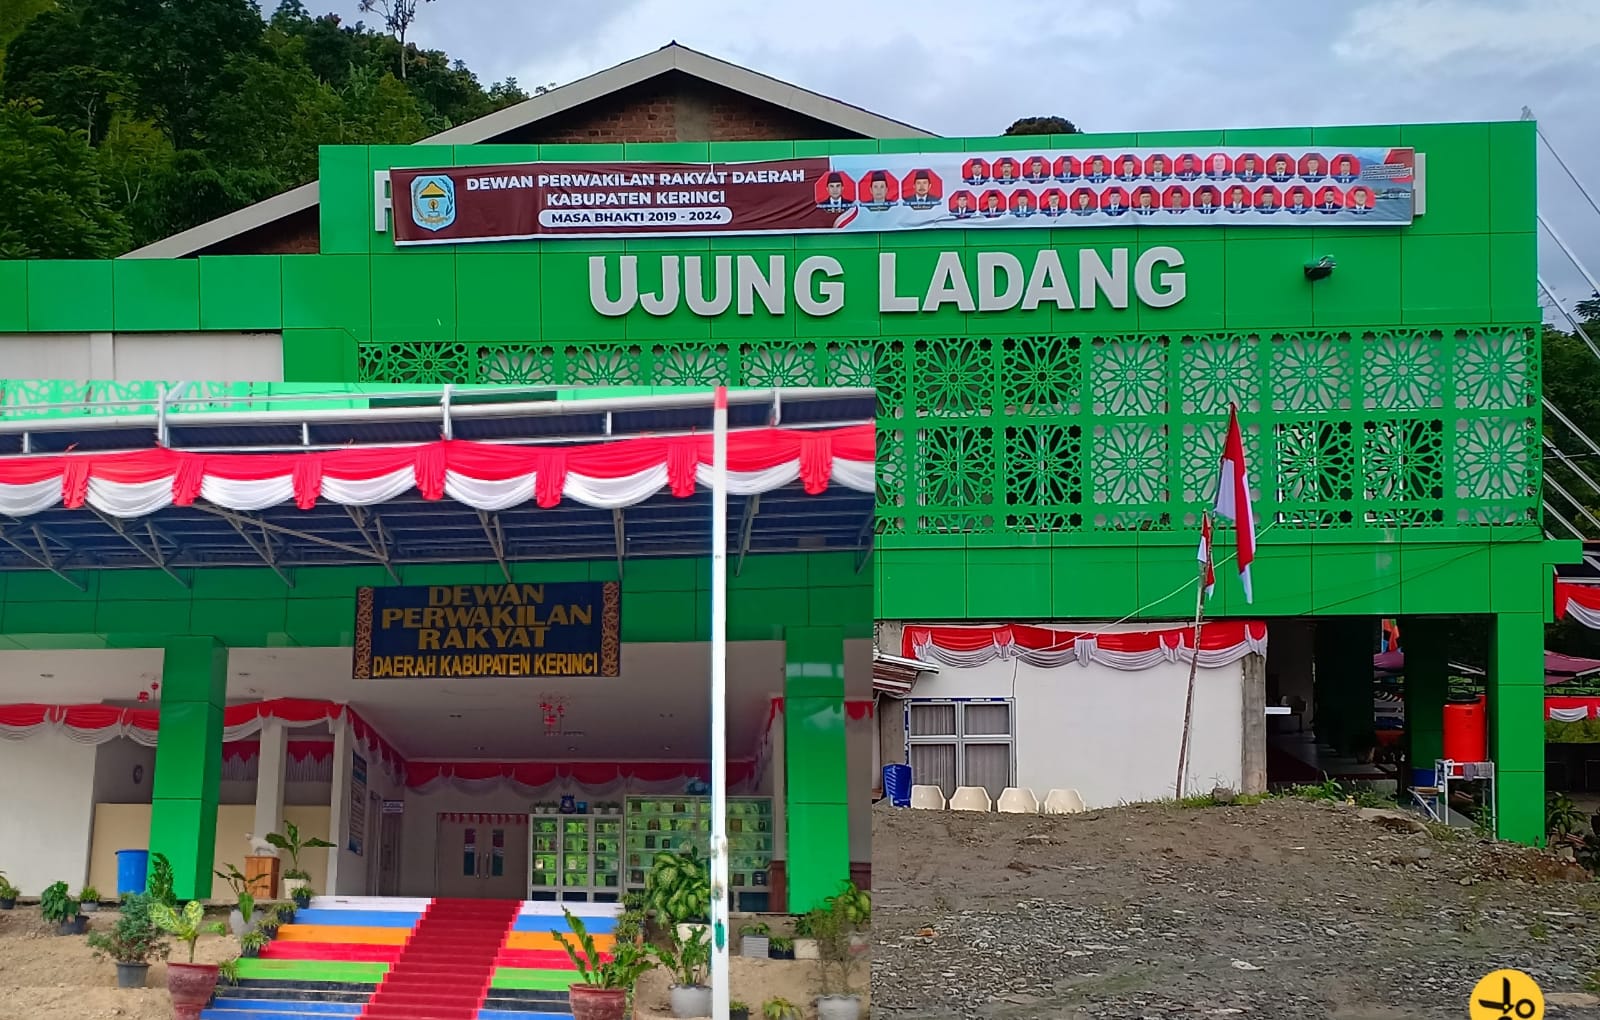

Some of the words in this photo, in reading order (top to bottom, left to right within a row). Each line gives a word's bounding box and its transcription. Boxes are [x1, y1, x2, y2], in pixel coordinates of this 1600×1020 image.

[466, 175, 533, 191] DEWAN
[538, 172, 655, 187] PERWAKILAN
[659, 171, 728, 186] RAKYAT
[731, 169, 805, 184] DAERAH
[547, 191, 652, 207] KABUPATEN
[656, 190, 725, 204] KERINCI
[551, 212, 591, 224] MASA
[594, 212, 645, 223] BHAKTI
[648, 211, 677, 222] 2019
[688, 210, 722, 221] 2024
[588, 255, 845, 317] UJUNG
[878, 246, 1187, 313] LADANG
[429, 584, 545, 606] DEWAN
[381, 604, 592, 629] PERWAKILAN
[417, 627, 550, 650] RAKYAT
[373, 655, 437, 677] DAERAH
[440, 654, 531, 676] KABUPATEN
[534, 652, 598, 675] KERINCI
